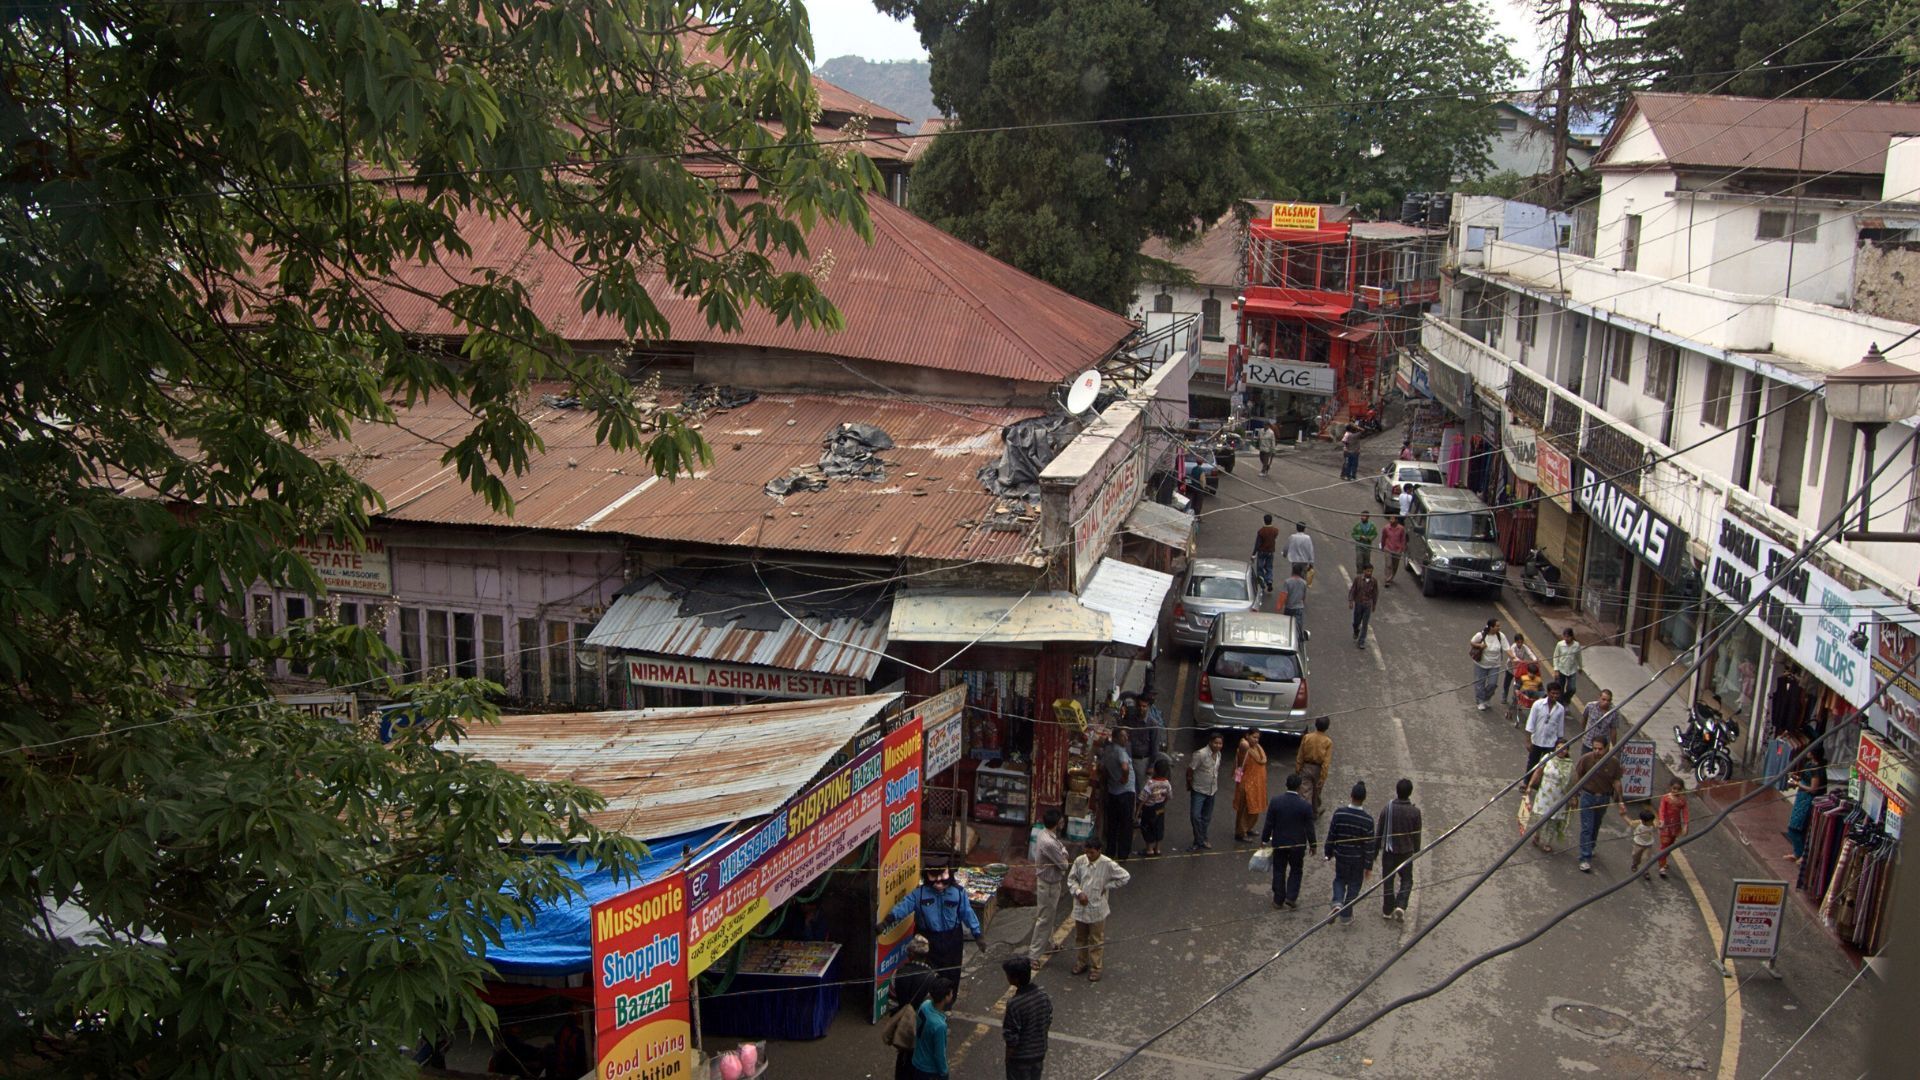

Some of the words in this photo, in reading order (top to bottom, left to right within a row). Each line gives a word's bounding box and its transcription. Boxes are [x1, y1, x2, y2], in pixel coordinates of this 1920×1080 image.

[1274, 206, 1316, 218] KALSANG
[1249, 364, 1311, 387] RAGE
[1581, 467, 1669, 566] BANGAS
[325, 535, 385, 554] ASHAM
[632, 662, 700, 684] NIRMAL
[707, 669, 781, 692] ASHRAM
[787, 675, 857, 697] ESTATE
[1815, 635, 1856, 688] TAILORS
[885, 730, 921, 772] Mussoorie
[885, 766, 920, 808] Shopping
[719, 810, 788, 890] MUSSOORIE
[788, 768, 851, 840] SHOPPING
[889, 802, 915, 839] Bazzar
[689, 916, 700, 944] A
[702, 896, 724, 932] Good
[760, 843, 805, 888] Exhibition
[817, 800, 860, 845] Handicraft
[883, 859, 899, 878] Good
[900, 844, 919, 866] Living
[885, 863, 916, 896] Exhibition
[598, 884, 683, 943] Mussoorie
[603, 932, 681, 989] Shopping
[880, 952, 900, 973] Entry
[615, 979, 672, 1030] Bazzar
[605, 1048, 640, 1080] Good
[646, 1034, 685, 1063] Living
